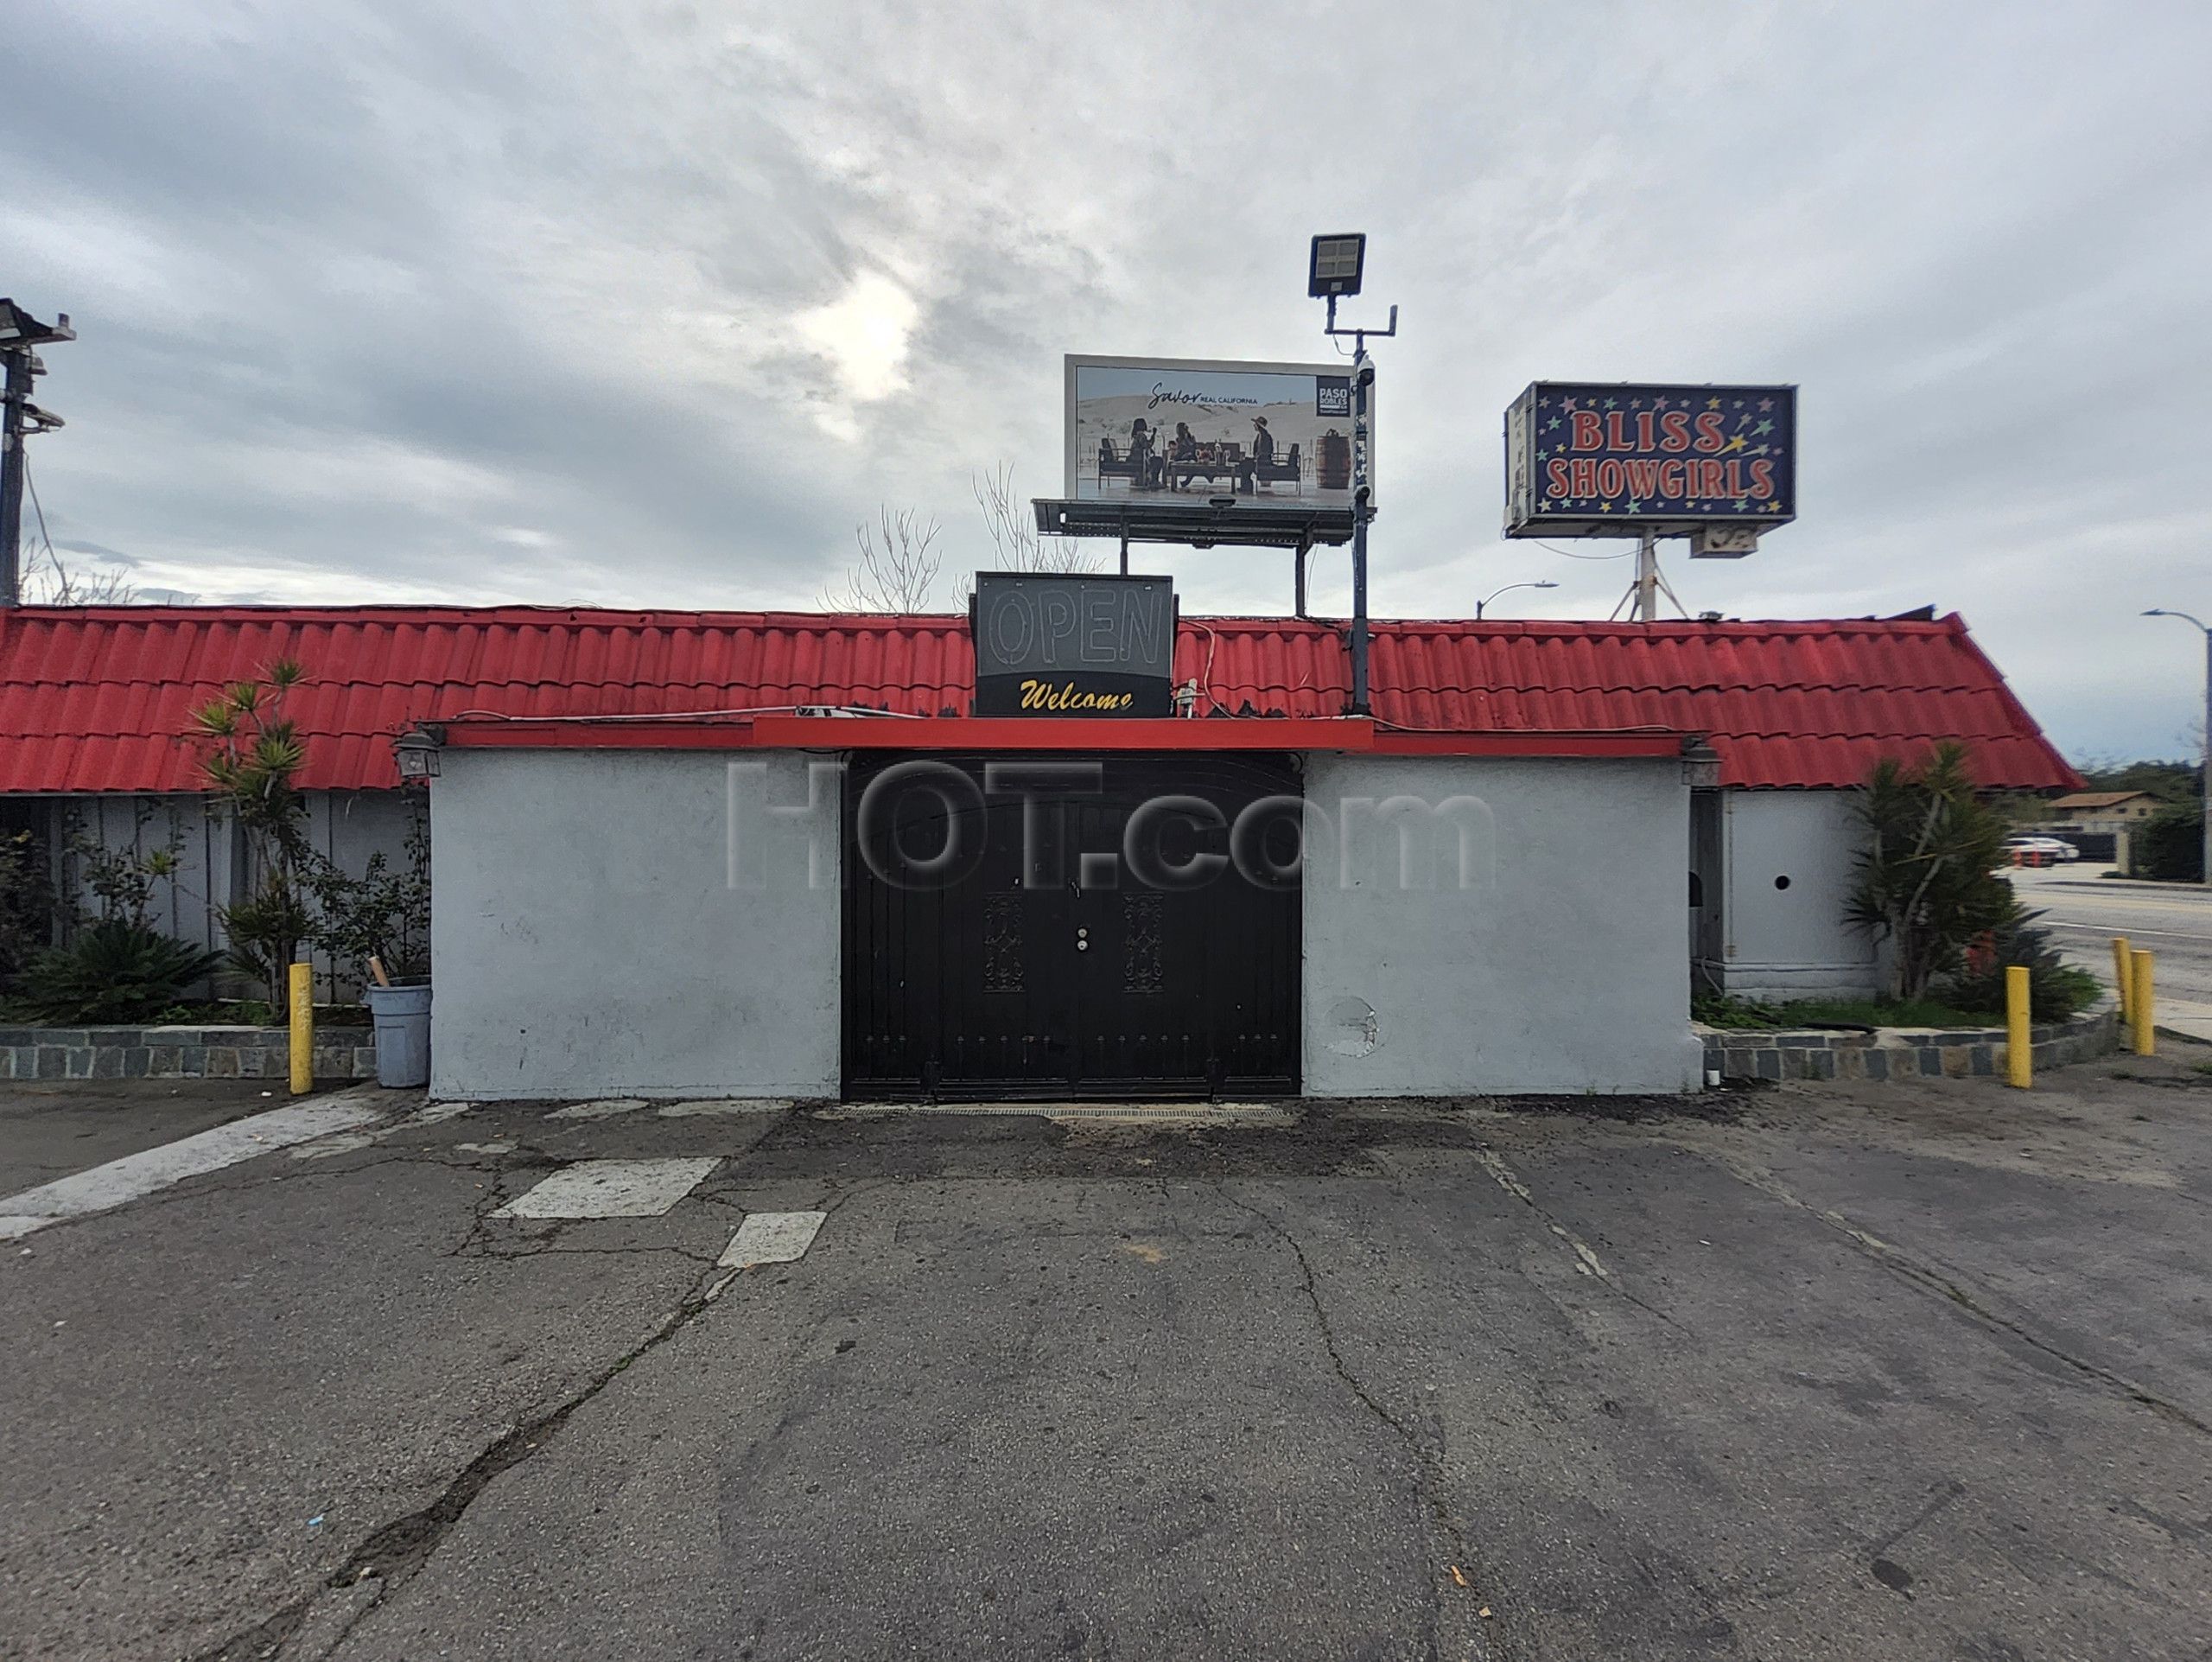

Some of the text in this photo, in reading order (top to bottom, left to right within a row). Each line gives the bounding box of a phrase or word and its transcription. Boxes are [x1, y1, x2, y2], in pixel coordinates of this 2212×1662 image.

[1148, 382, 1202, 410] Savor
[1319, 387, 1347, 398] PASO
[1570, 410, 1726, 453] BLISS
[1546, 458, 1775, 500] SHOWGIRLS
[988, 589, 1162, 665] OPEN
[1020, 679, 1134, 711] Welcome
